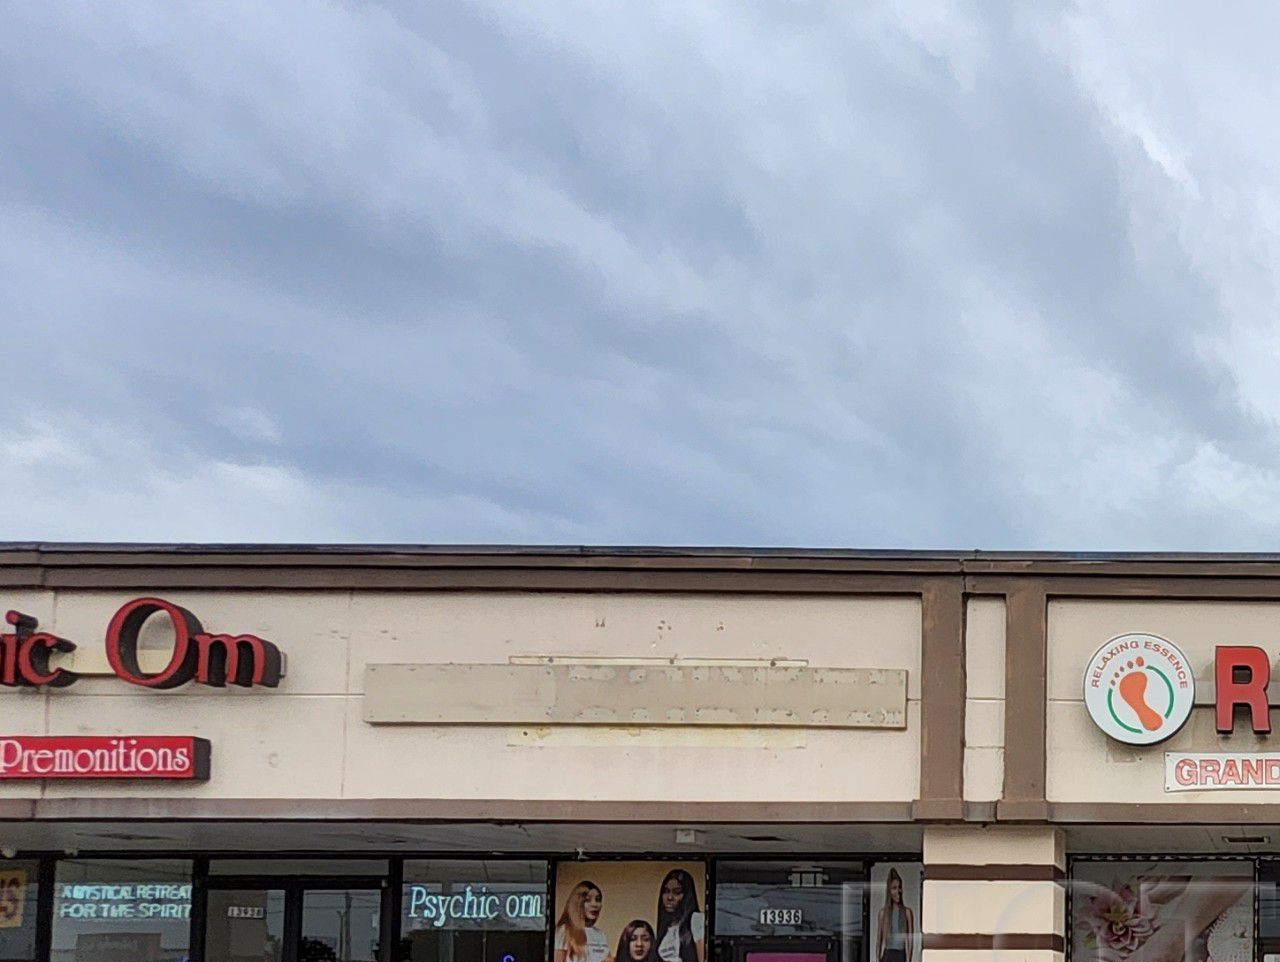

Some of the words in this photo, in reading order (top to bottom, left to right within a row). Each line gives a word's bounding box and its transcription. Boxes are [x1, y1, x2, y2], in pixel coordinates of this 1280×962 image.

[105, 597, 268, 688] Om
[1091, 641, 1140, 688] RELAXING
[1144, 641, 1189, 689] ESSENCE
[0, 739, 190, 774] Premonitions
[136, 885, 192, 899] RETREAT
[408, 885, 500, 927] Psychic
[60, 903, 96, 918] FOR
[100, 904, 133, 918] THE
[138, 904, 192, 918] SPIRIT
[761, 910, 801, 923] 13936
